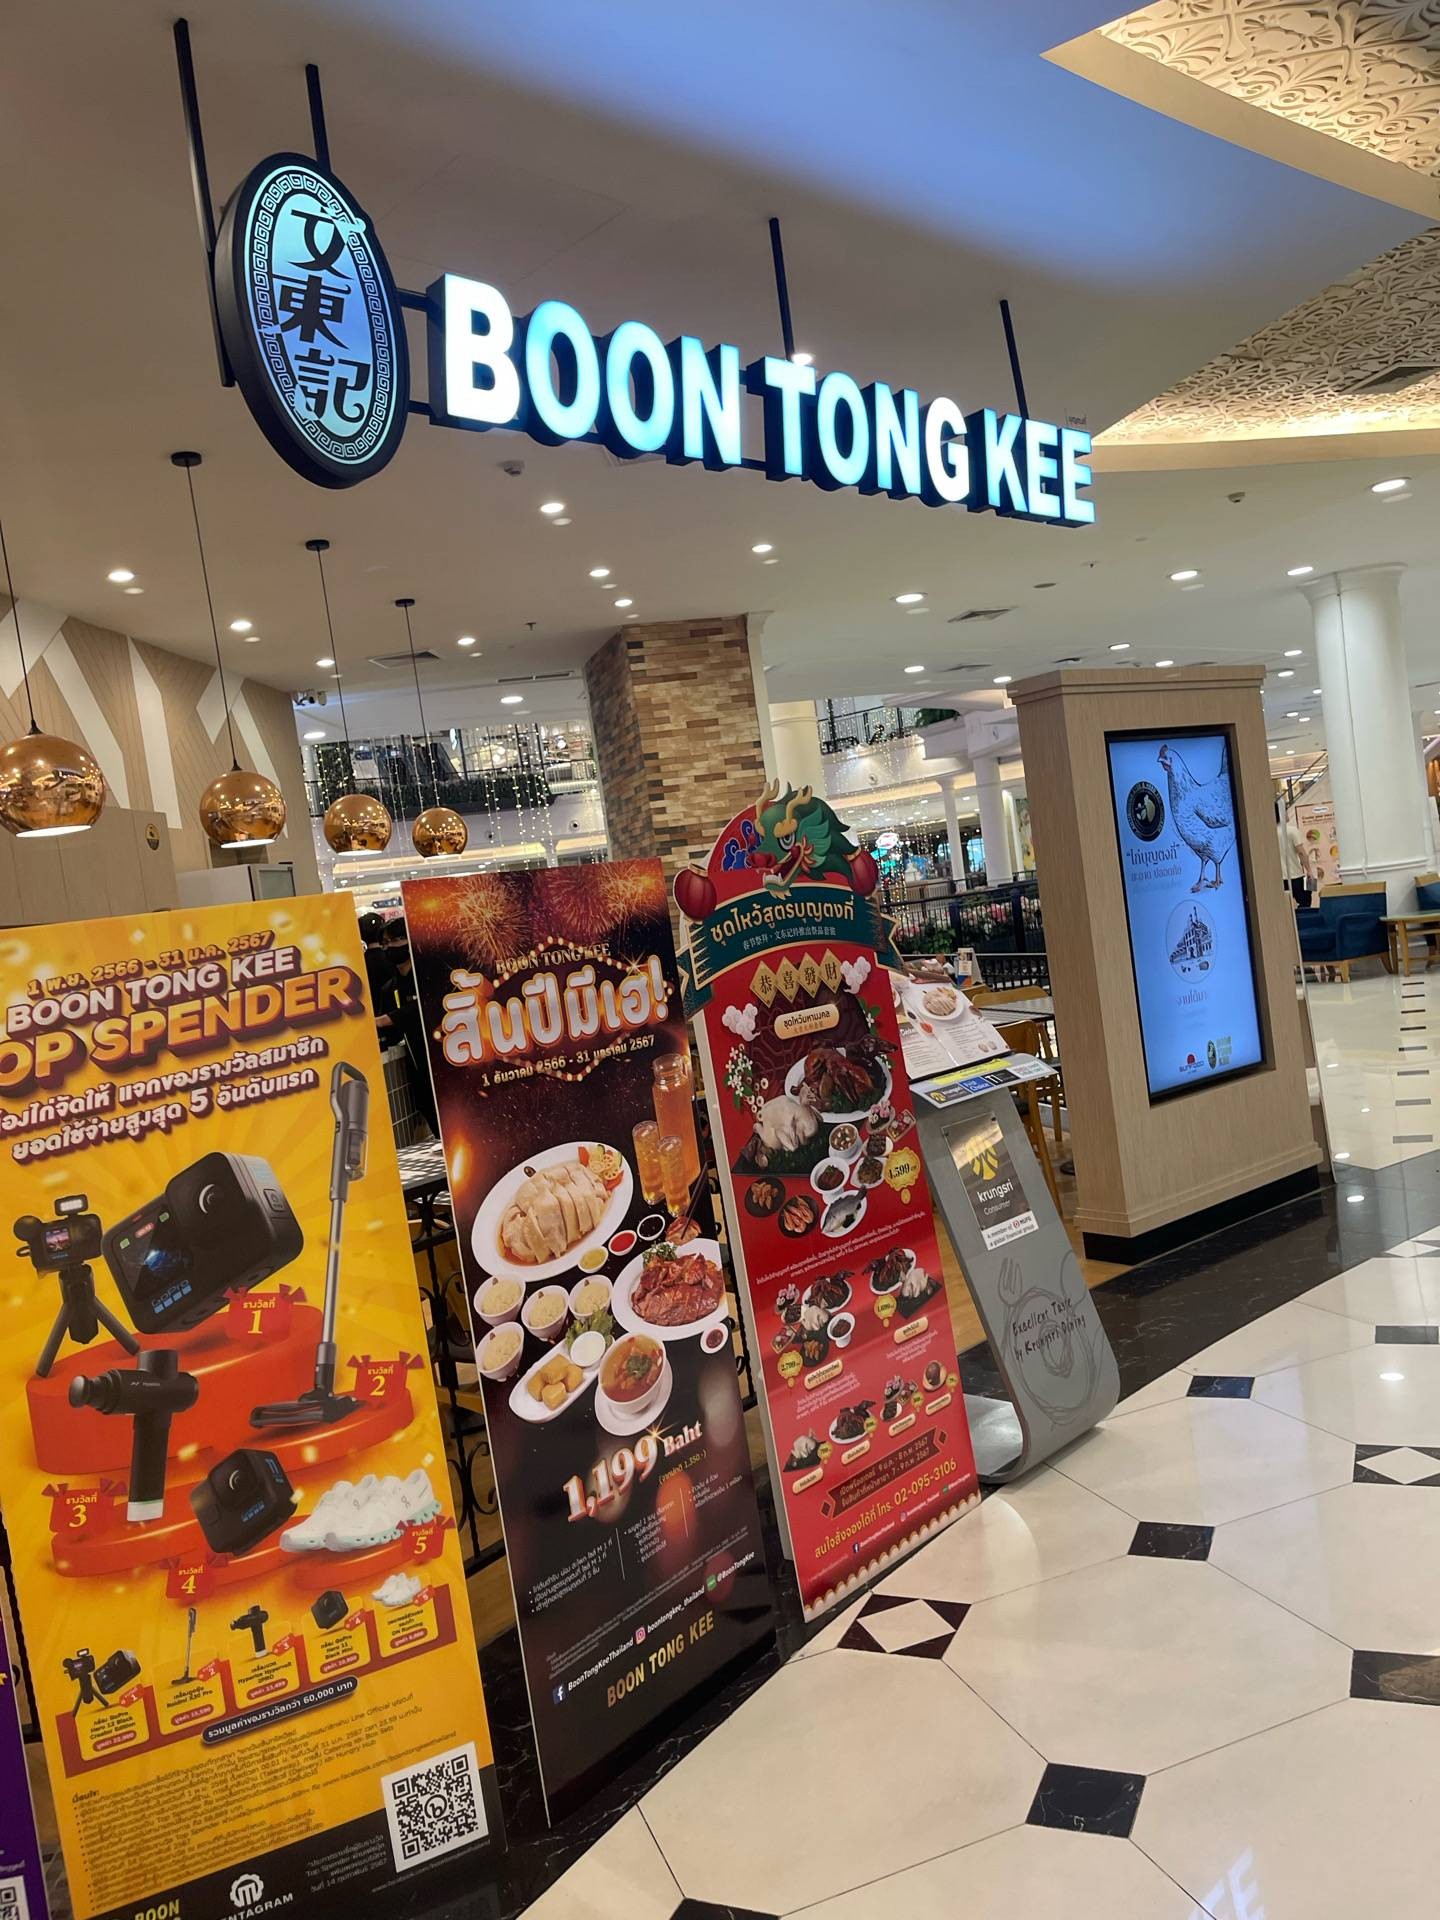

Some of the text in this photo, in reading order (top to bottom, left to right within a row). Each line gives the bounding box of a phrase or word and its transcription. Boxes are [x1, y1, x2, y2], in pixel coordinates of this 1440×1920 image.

[445, 273, 1096, 525] BOON TONG KEE
[711, 895, 854, 945] ชุดไหว้สูตรบุญตงกี่
[28, 979, 41, 996] 1
[91, 960, 140, 985] 2566
[160, 951, 182, 967] 31
[228, 931, 274, 951] 2567
[497, 956, 540, 975] BOON
[541, 951, 580, 967] TONG
[760, 962, 837, 994] 恭喜發財
[6, 947, 297, 1034] BOON TONG KEE
[92, 969, 355, 1063] SPENDER
[443, 955, 669, 1066] สิ้นปีมีเฮ!
[537, 1056, 566, 1072] 2566
[577, 1051, 590, 1063] 31
[629, 1034, 655, 1050] 2567
[0, 1036, 325, 1132] องไก่จัดให้ แจกของรางวัลสมาชิก
[13, 1069, 314, 1160] ยอดใช้จ่ายสูงสุด 5 อันดับแรก
[977, 1178, 1014, 1203] krungsri
[983, 1200, 1011, 1216] Consumer
[242, 1297, 276, 1310] รางวัลที่
[248, 1311, 264, 1334] 1
[367, 1364, 394, 1377] รางวัลที่
[370, 1376, 386, 1397] 2
[563, 1420, 703, 1523] 1,199 Baht
[66, 1492, 97, 1505] รางวัลที่
[69, 1505, 87, 1529] 3
[813, 1455, 957, 1559] สนใจสั่งจองได้ที่ โทร. 02-095-3106
[414, 1536, 428, 1554] 5
[180, 1575, 197, 1594] 4
[568, 1637, 634, 1692] BoonTongKeeThailand
[607, 1663, 645, 1708] BOON
[649, 1637, 685, 1675] TONG
[689, 1610, 714, 1645] KEE
[208, 1681, 353, 1738] รวมมูลค่าของรางวัลกว่า 60,000 บาท
[220, 1893, 294, 1920] NTAGRAM
